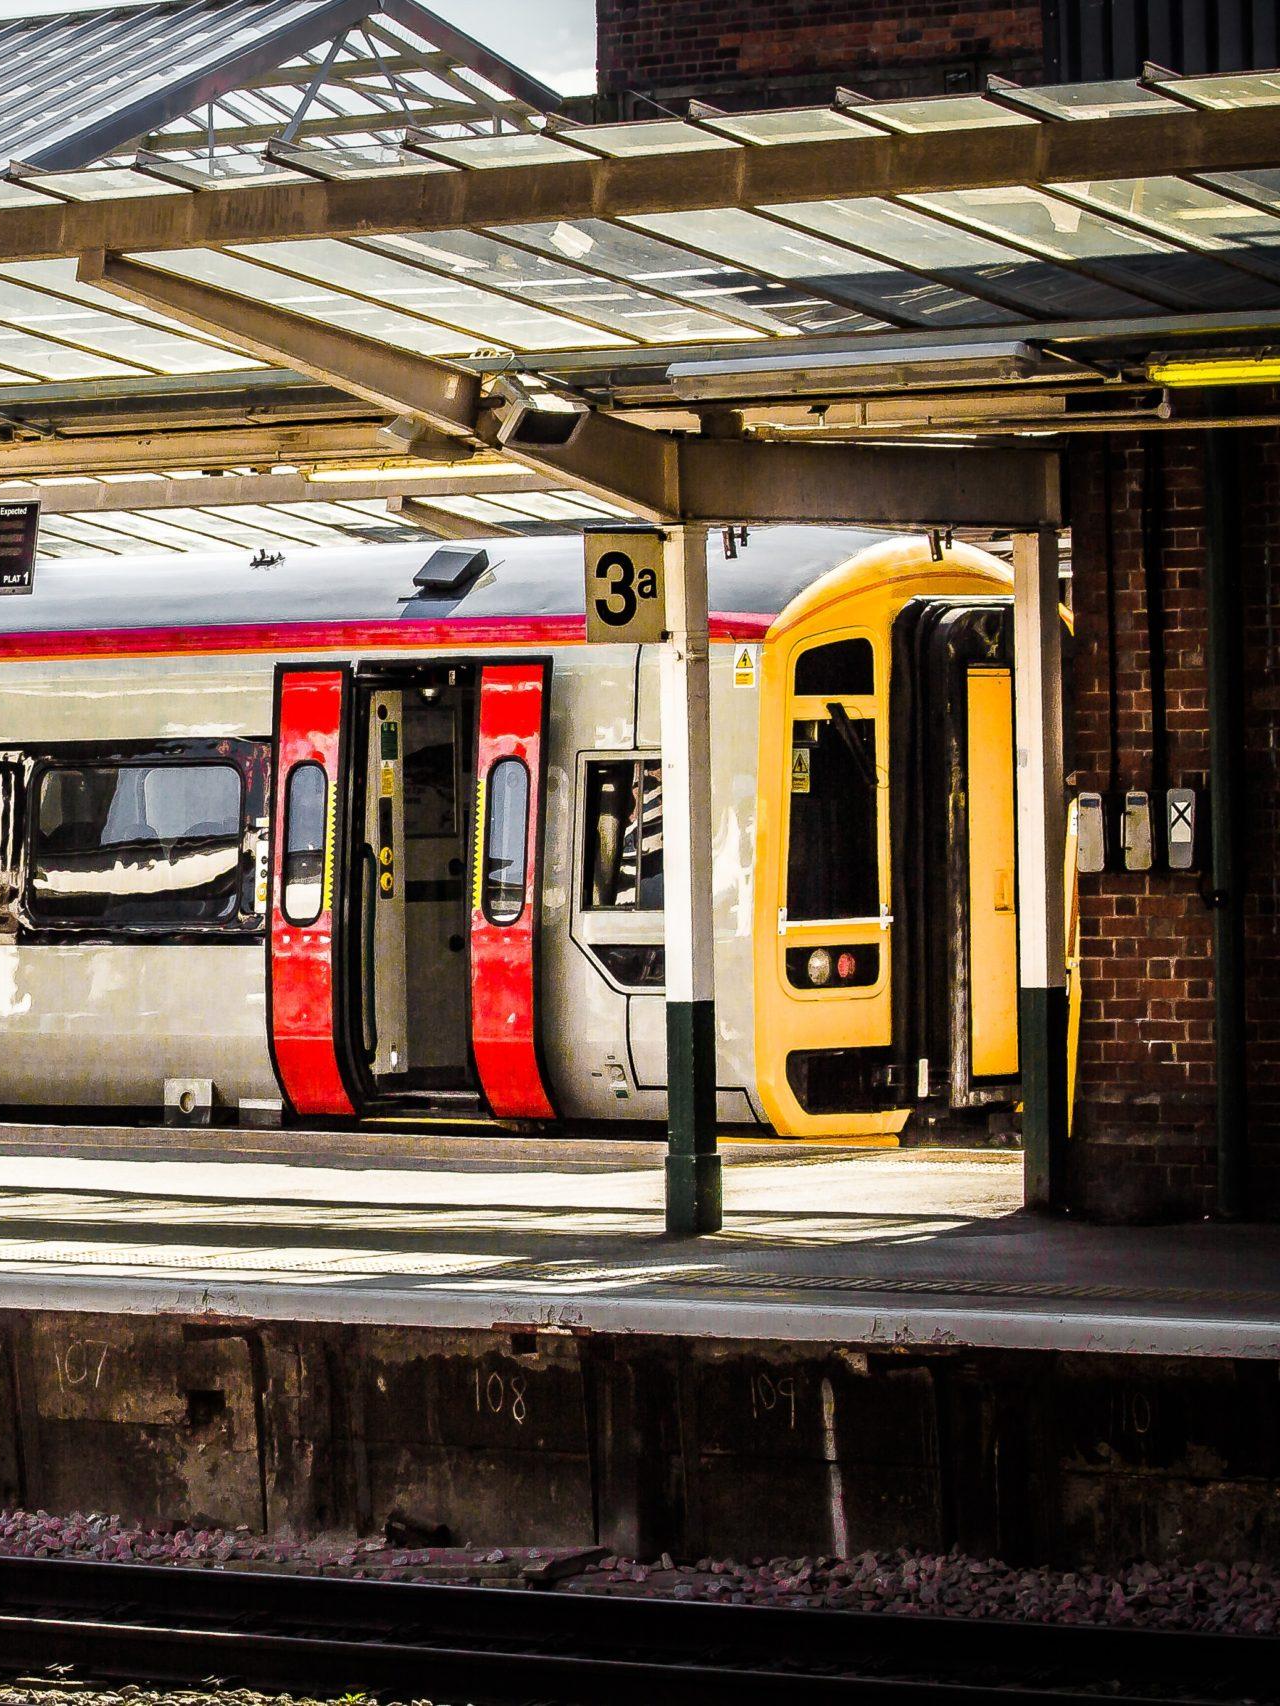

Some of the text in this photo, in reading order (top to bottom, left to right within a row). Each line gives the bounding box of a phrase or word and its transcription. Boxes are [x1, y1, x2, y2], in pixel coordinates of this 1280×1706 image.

[0, 507, 28, 517] Expected
[3, 572, 29, 585] PLAT 1
[594, 550, 658, 627] 3a
[53, 1339, 108, 1393] 107
[475, 1368, 527, 1424] 108
[751, 1374, 795, 1429] 109
